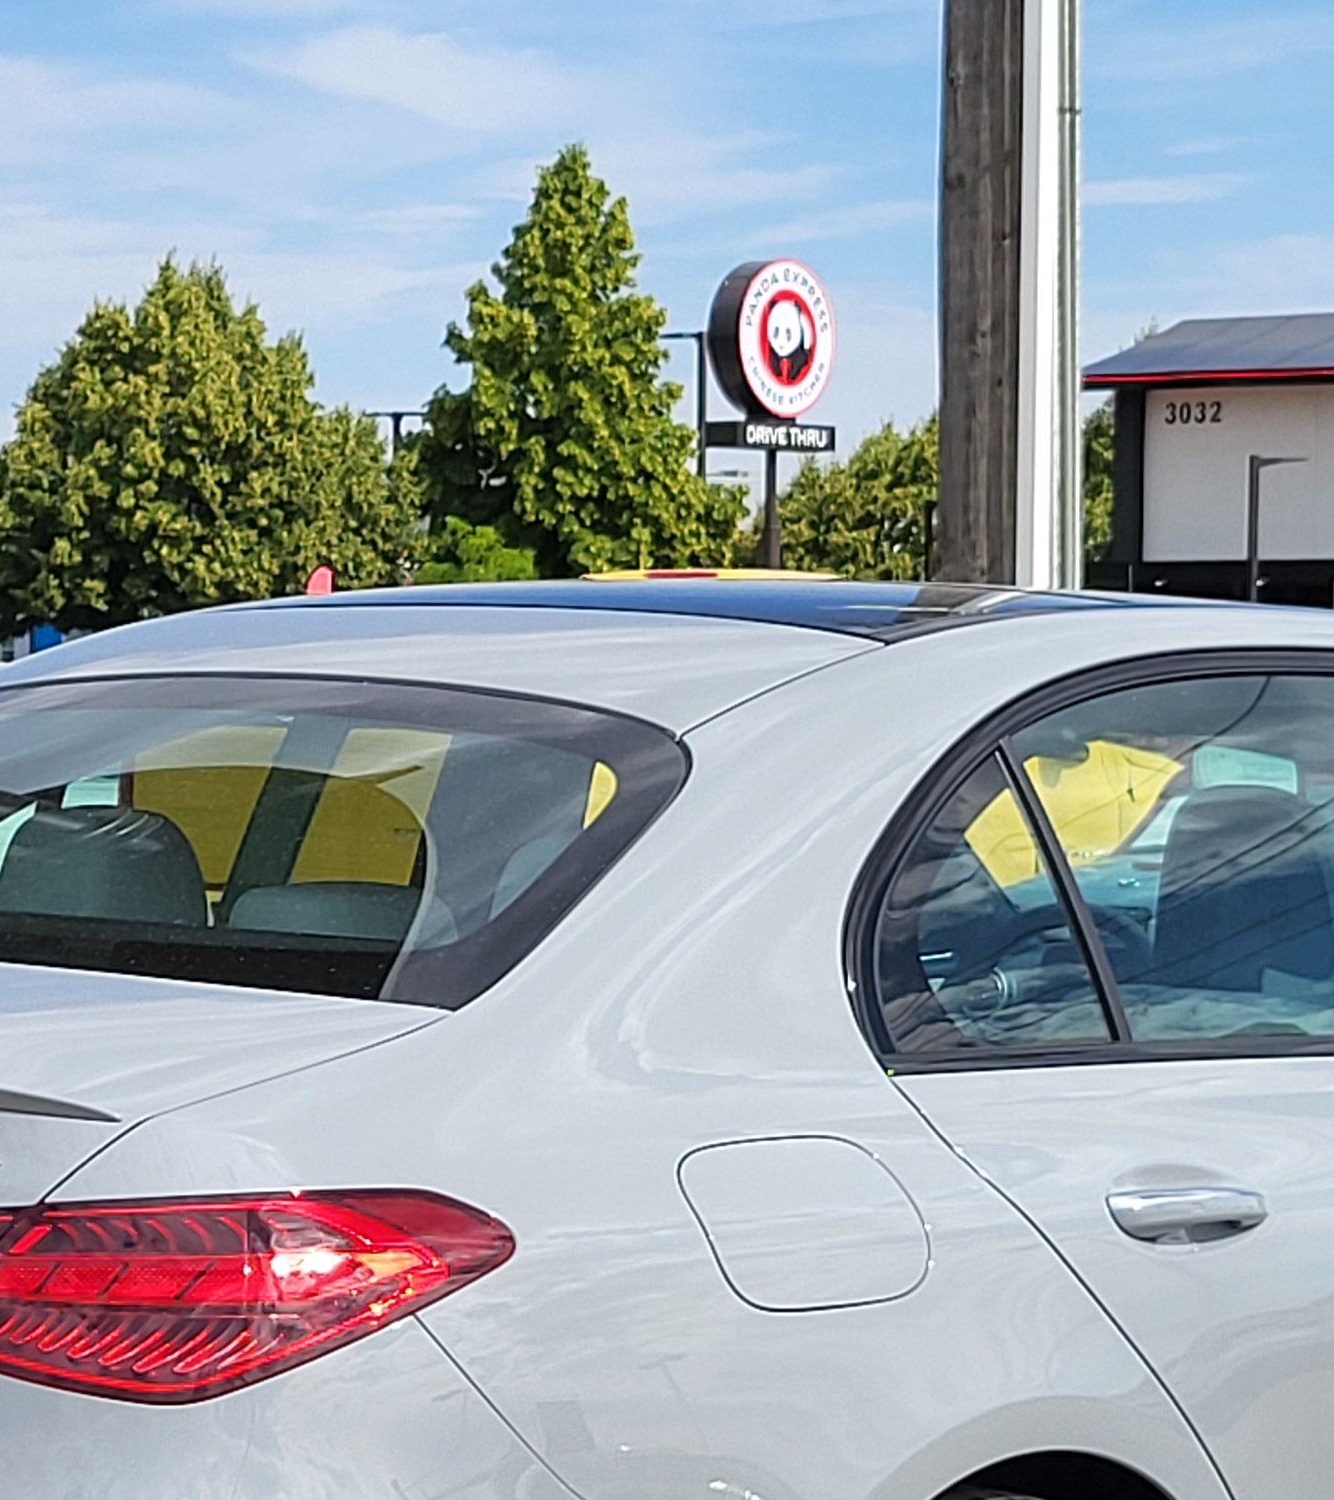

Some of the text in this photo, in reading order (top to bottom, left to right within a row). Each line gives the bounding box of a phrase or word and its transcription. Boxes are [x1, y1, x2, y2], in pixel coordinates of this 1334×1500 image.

[745, 271, 780, 327] PANDA
[1165, 401, 1222, 424] 3032
[746, 424, 828, 448] DRIVE THRU
